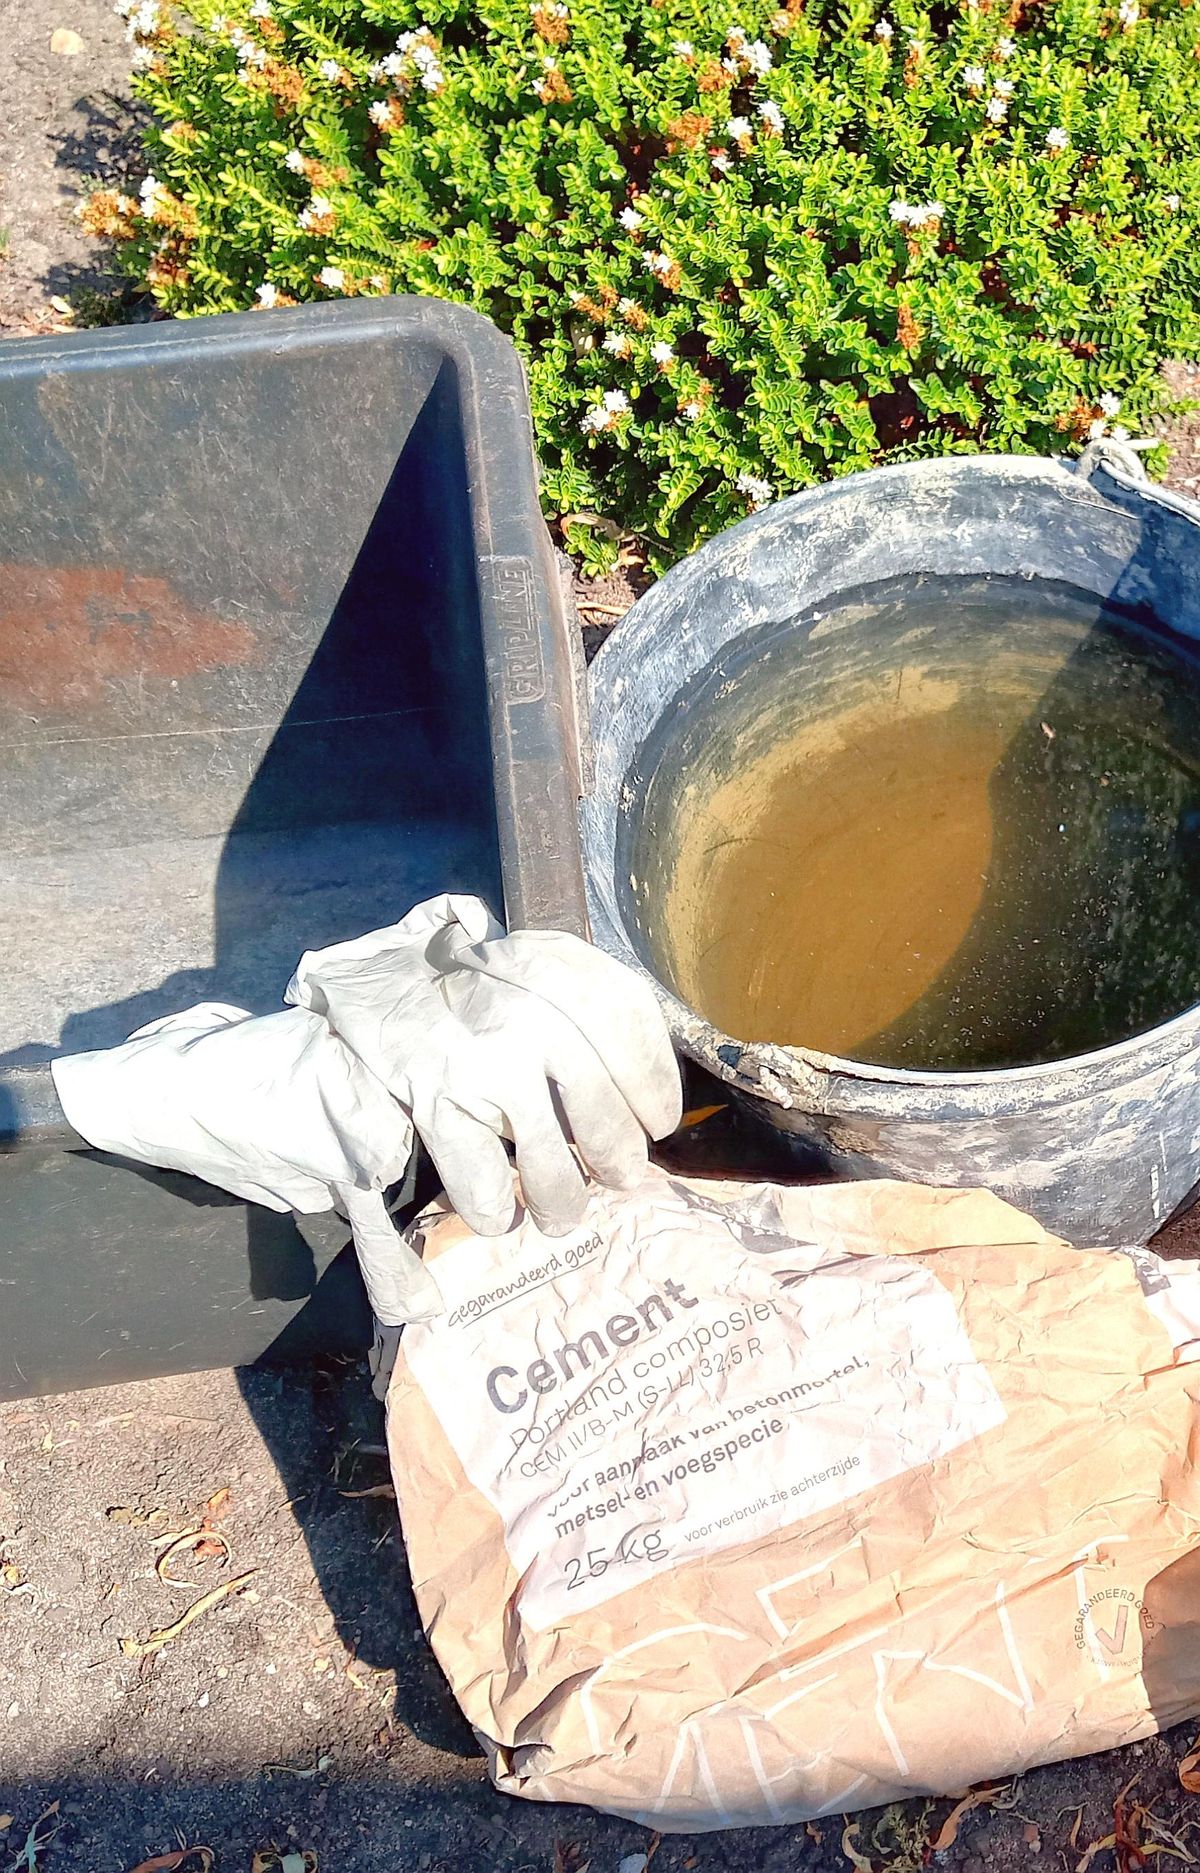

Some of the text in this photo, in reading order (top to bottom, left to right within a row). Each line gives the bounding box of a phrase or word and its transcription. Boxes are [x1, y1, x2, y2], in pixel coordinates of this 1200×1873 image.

[564, 1231, 604, 1269] goed
[486, 1277, 700, 1415] Cement
[509, 1299, 784, 1449] Portland composiet
[520, 1441, 568, 1479] CEM
[700, 1344, 743, 1378] 32,5
[747, 1337, 765, 1358] R
[689, 1420, 727, 1440] van
[662, 1416, 784, 1486] voegspecie
[683, 1455, 861, 1543] voor verbruik zie achterzijde
[564, 1528, 670, 1591] 25 kg
[1074, 1588, 1155, 1650] GEGARANDEERD GOED
